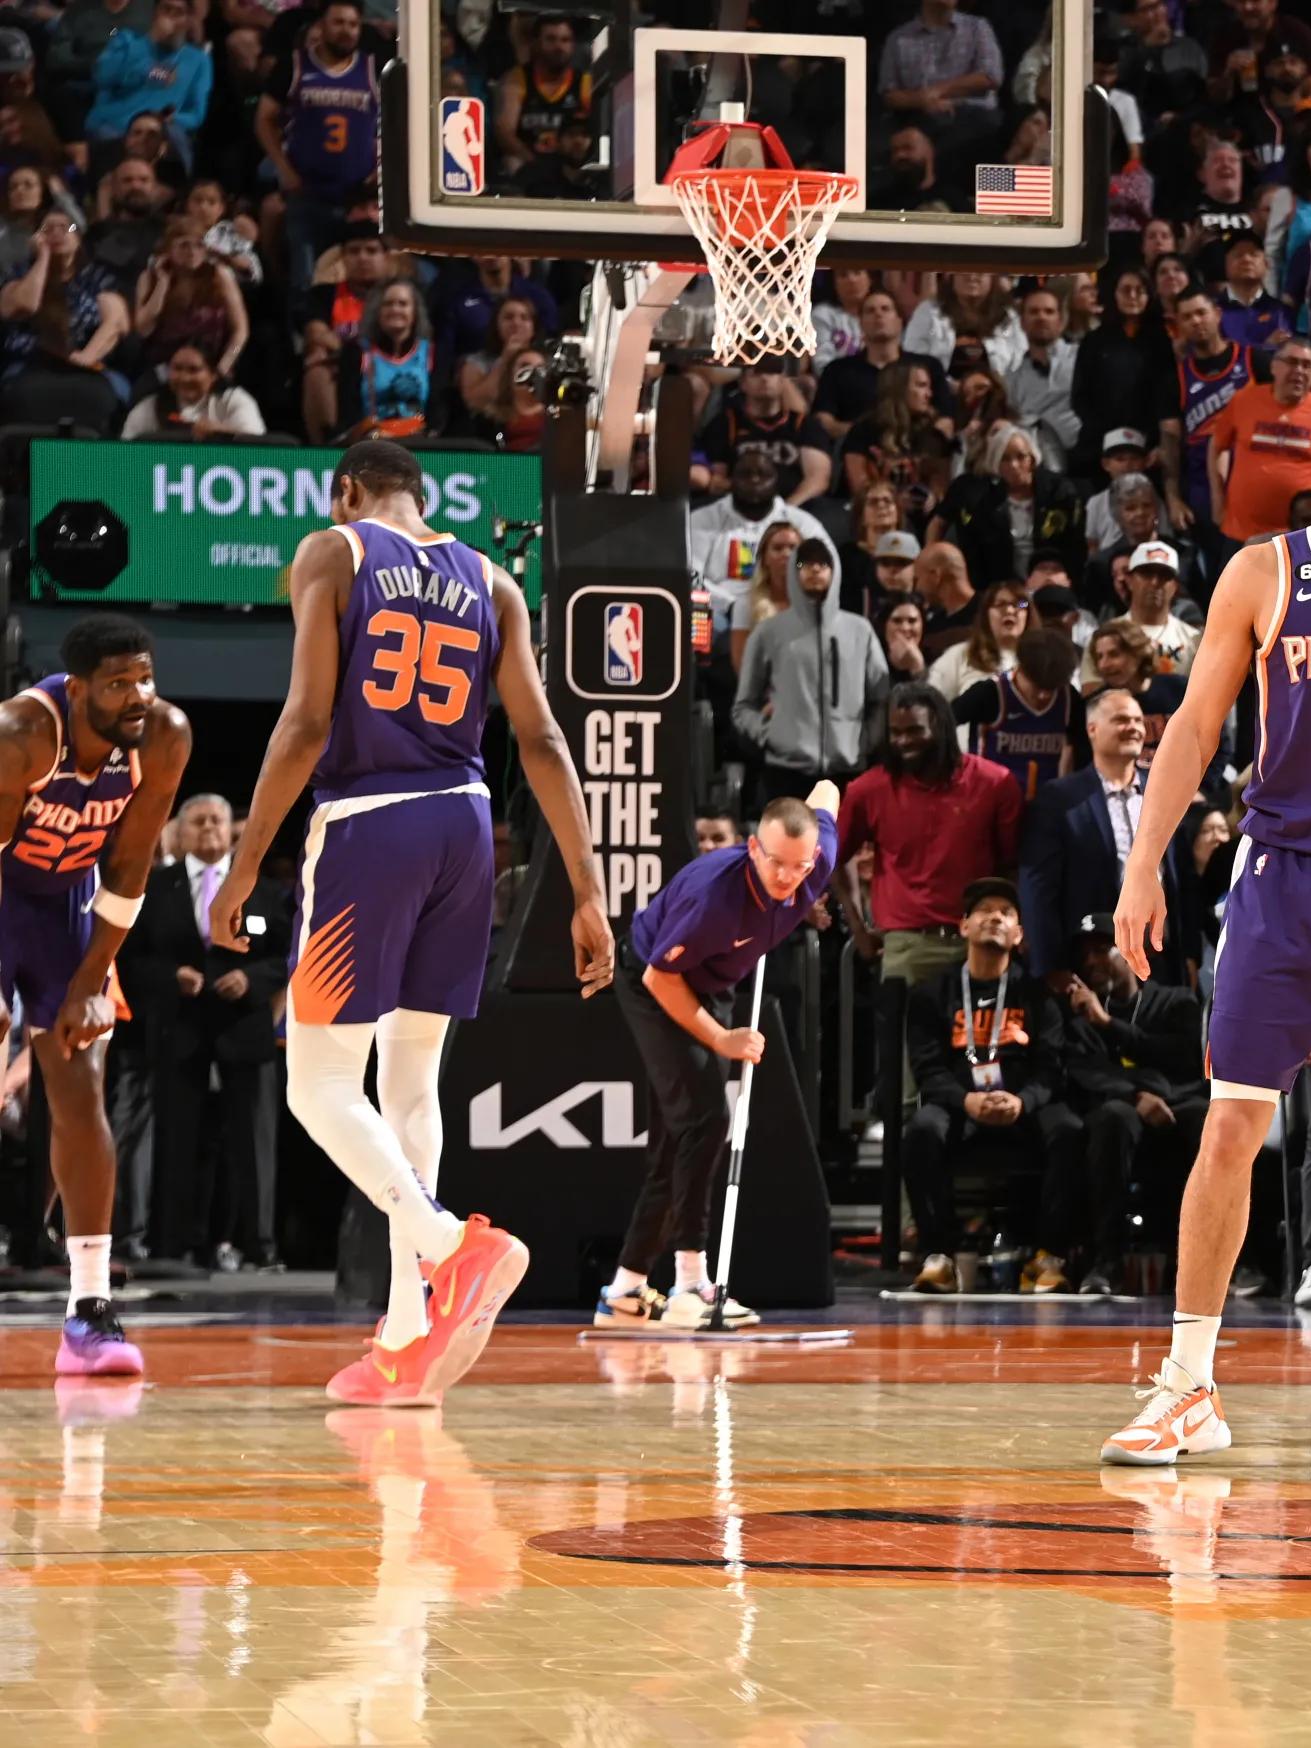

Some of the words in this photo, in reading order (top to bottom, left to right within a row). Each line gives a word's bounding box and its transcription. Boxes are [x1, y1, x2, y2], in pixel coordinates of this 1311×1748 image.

[323, 113, 350, 155] 3
[447, 171, 469, 189] NBA
[210, 544, 282, 568] OFFICIAL
[375, 565, 480, 618] DURANT
[362, 609, 481, 726] 35
[610, 663, 629, 680] NBA
[584, 709, 662, 776] GET
[583, 781, 662, 847] THE
[12, 827, 108, 874] 22
